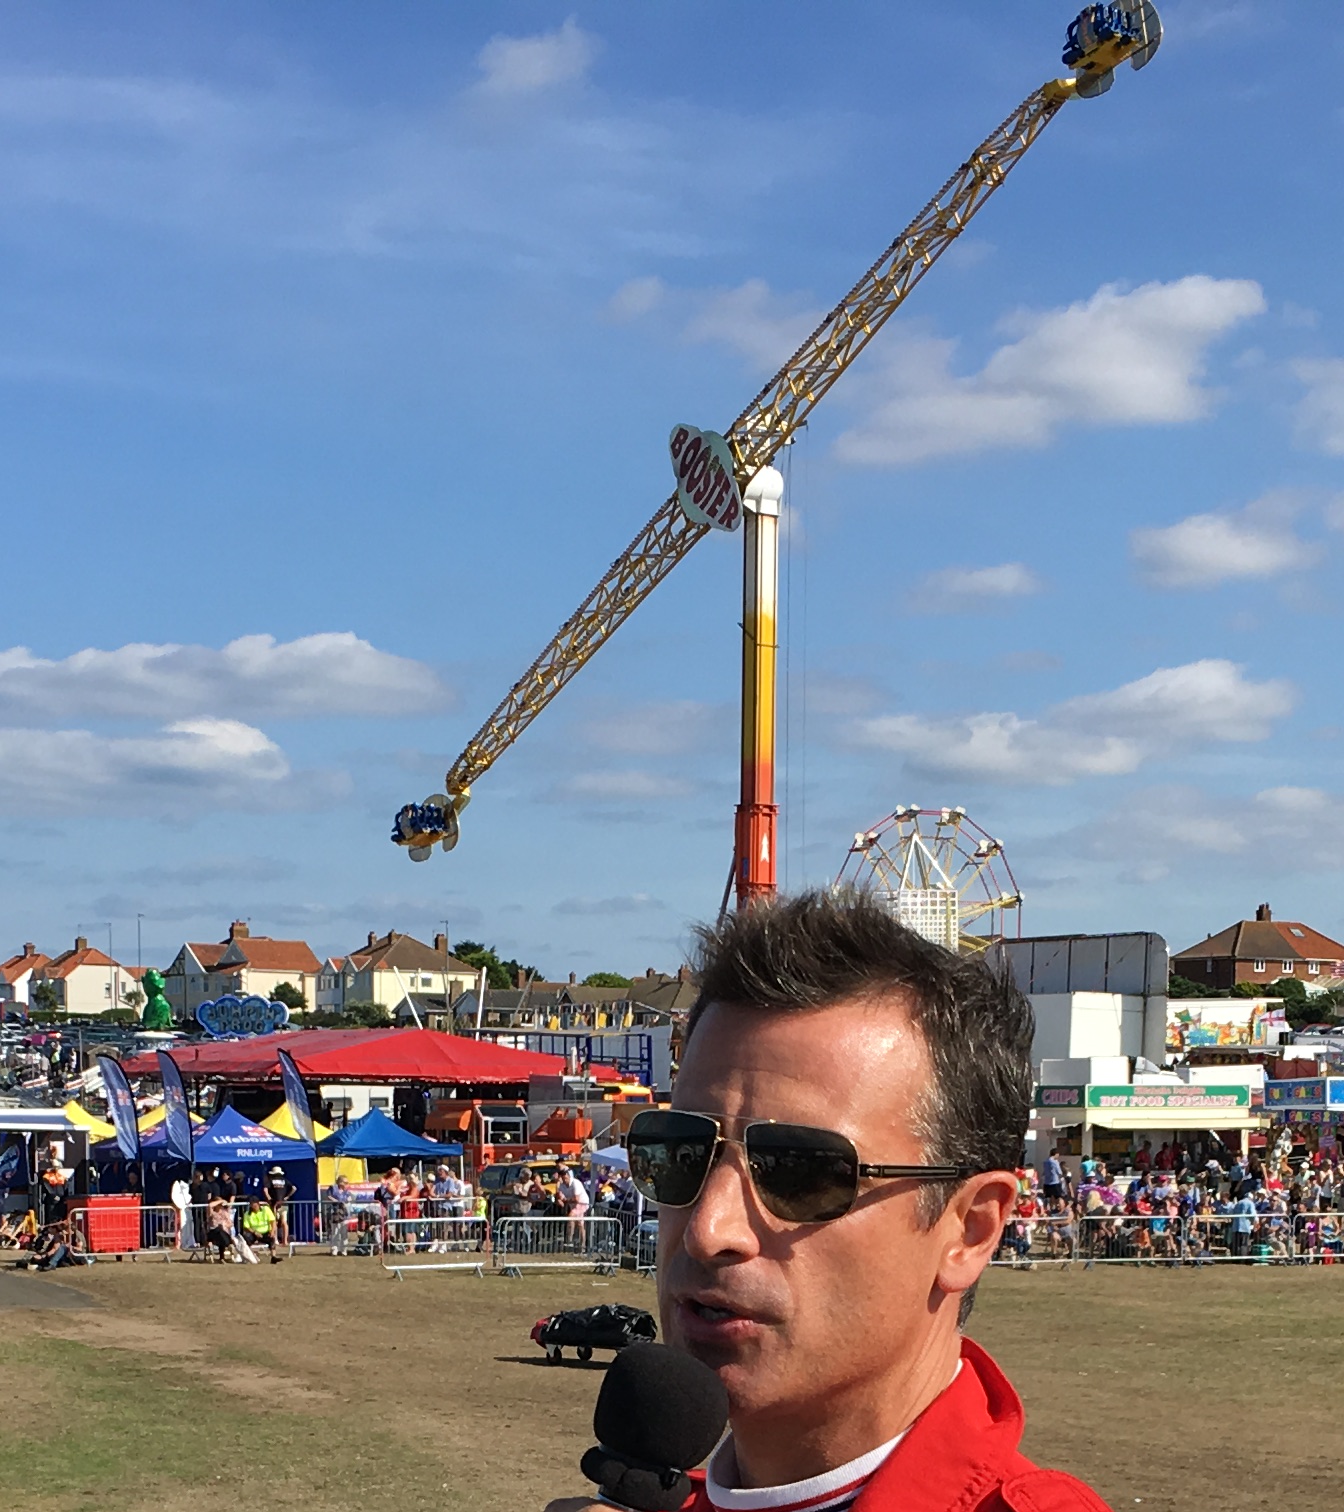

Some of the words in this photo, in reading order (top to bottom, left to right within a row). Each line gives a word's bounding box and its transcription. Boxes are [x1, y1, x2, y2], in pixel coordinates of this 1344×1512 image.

[671, 428, 739, 529] BOOSTER
[1042, 1088, 1079, 1105] CHIPS
[1099, 1095, 1128, 1106] HOT
[1129, 1095, 1166, 1106] FOOD
[1167, 1095, 1239, 1106] SPECIALIST
[212, 1135, 283, 1144] Lifeboats
